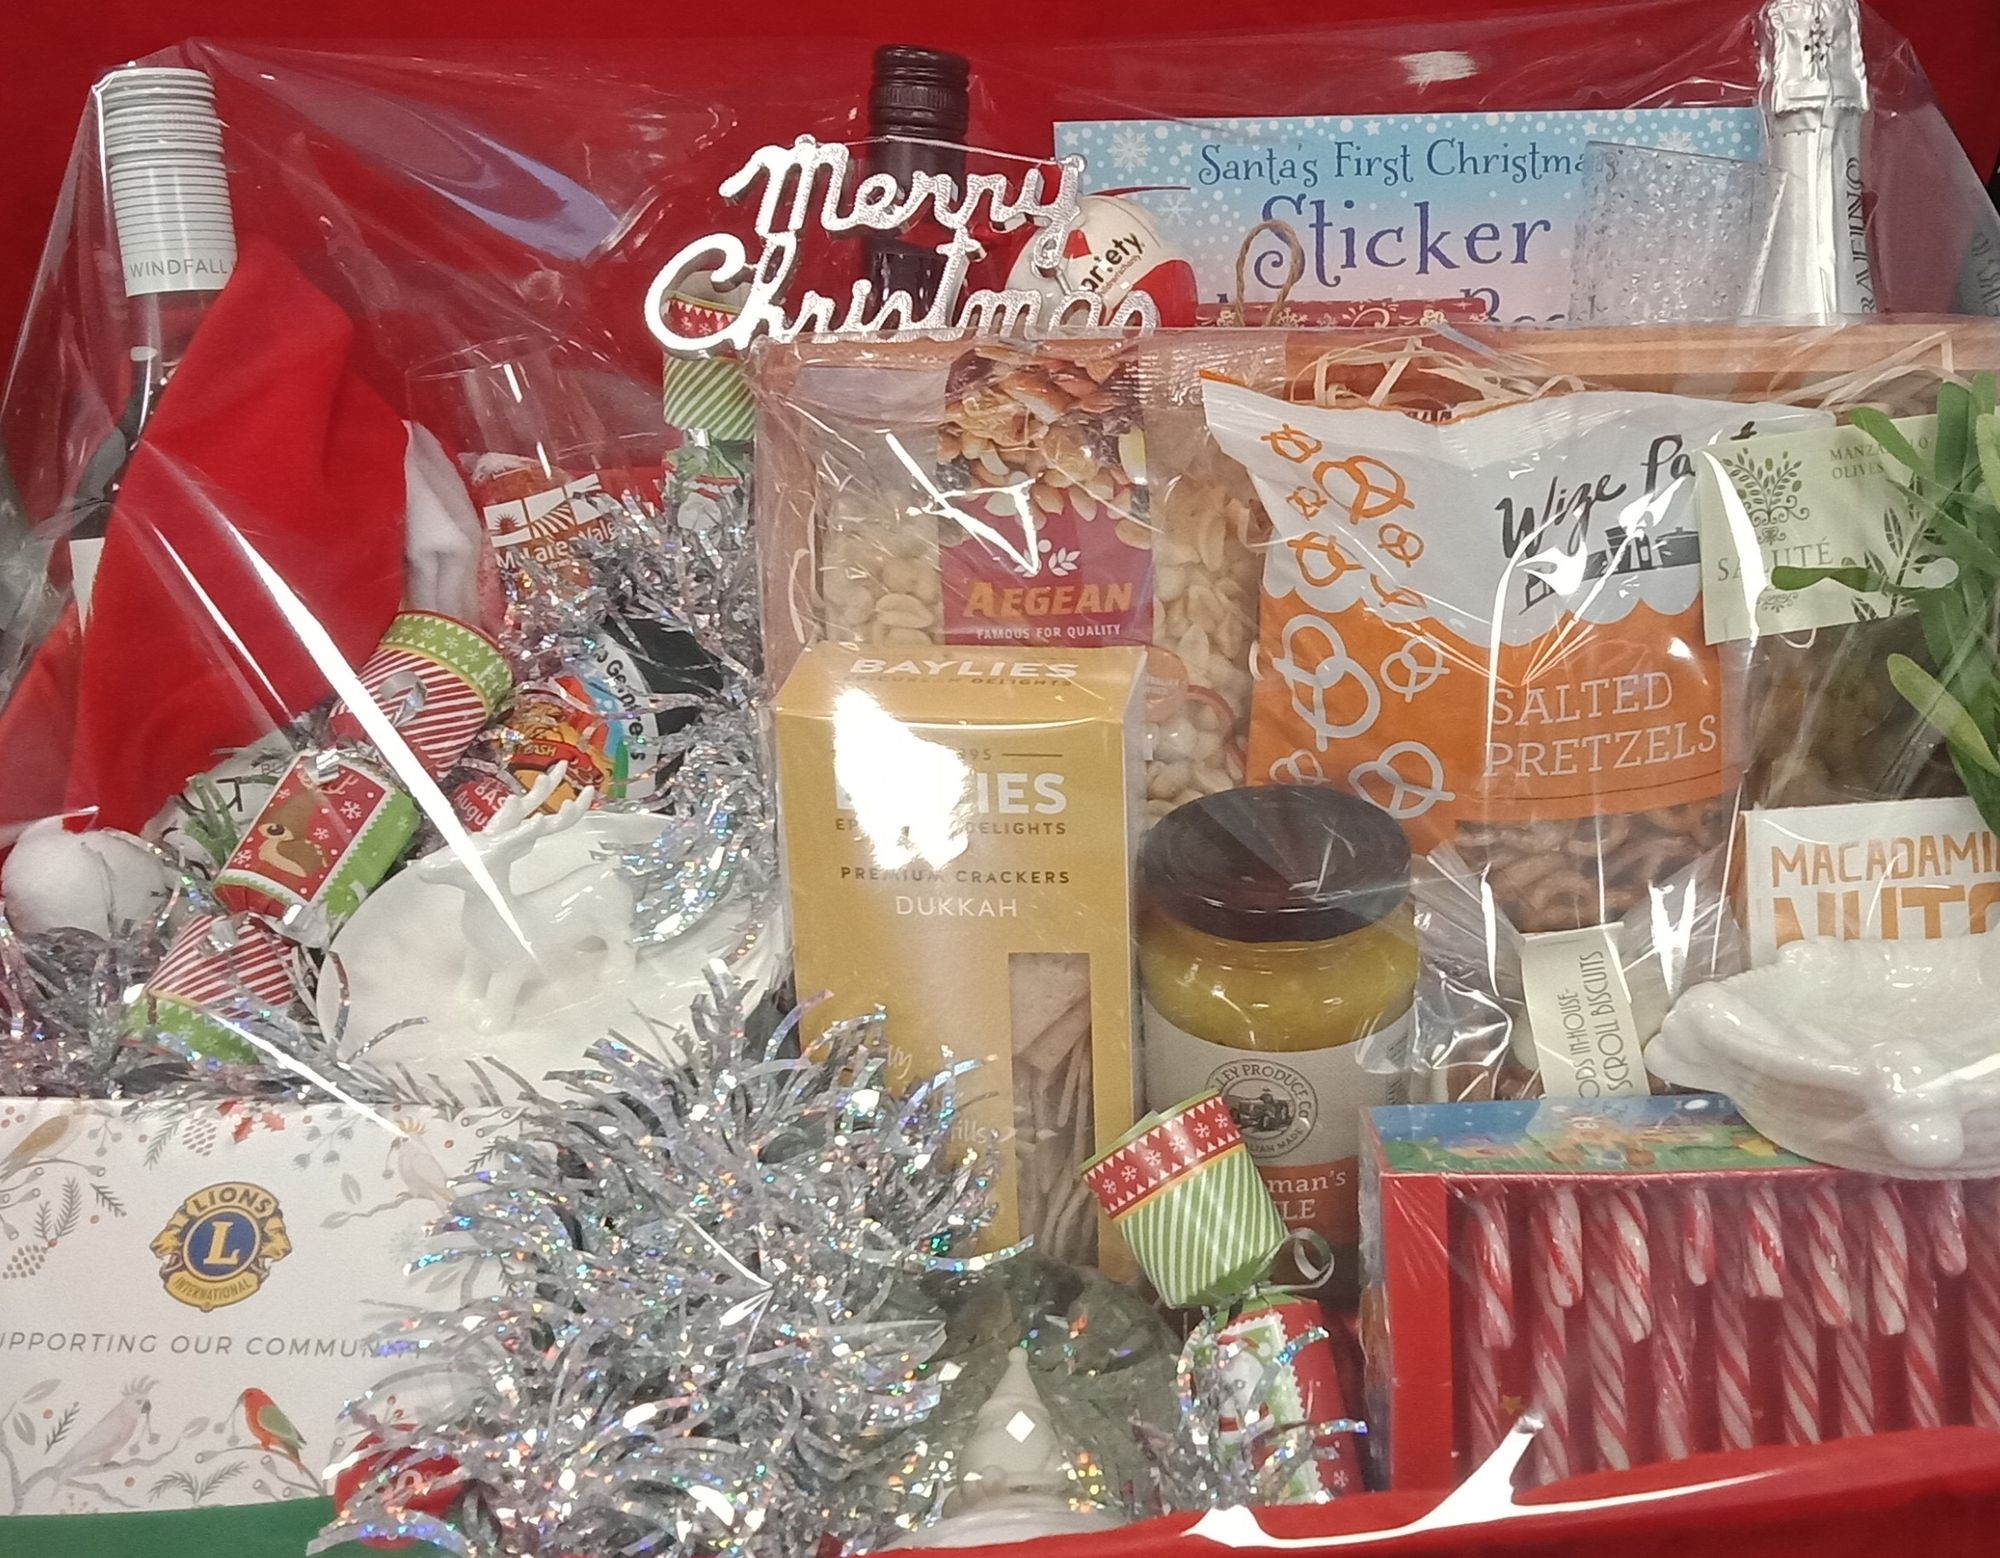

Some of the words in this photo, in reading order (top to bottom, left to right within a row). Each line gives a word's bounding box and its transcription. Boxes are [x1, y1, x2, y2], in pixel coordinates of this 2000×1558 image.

[1199, 143, 1318, 187] Santa's
[1334, 140, 1414, 186] First
[719, 134, 1088, 278] Merry
[1253, 193, 1551, 289] Sticker
[129, 258, 228, 278] WINDFALL
[1080, 231, 1144, 292] ariety
[963, 581, 1133, 617] AEGEAN
[977, 628, 1030, 640] FAMOUS
[1037, 626, 1062, 638] FOR
[1067, 623, 1121, 638] QUALITY
[850, 658, 1079, 678] BAYLIES
[1493, 671, 1673, 726] SALTED
[1483, 714, 1716, 777] PRETZELS
[454, 789, 489, 828] Augu
[956, 870, 1070, 884] CRACKERS
[1772, 832, 2000, 888] MACADAMI
[896, 896, 1018, 917] DUKKAH
[1579, 951, 1616, 1017] BISCUITS
[1593, 1019, 1633, 1091] SCROLL
[1215, 1067, 1241, 1091] LEY
[1242, 1064, 1308, 1100] PRODUCE
[192, 1187, 272, 1212] LIONS
[1265, 1171, 1347, 1193] man's
[1279, 1199, 1316, 1220] LE
[203, 1221, 240, 1265] L
[172, 1276, 253, 1301] INTERNATIONAL
[0, 1331, 157, 1354] PPORTING
[171, 1335, 232, 1355] OUR
